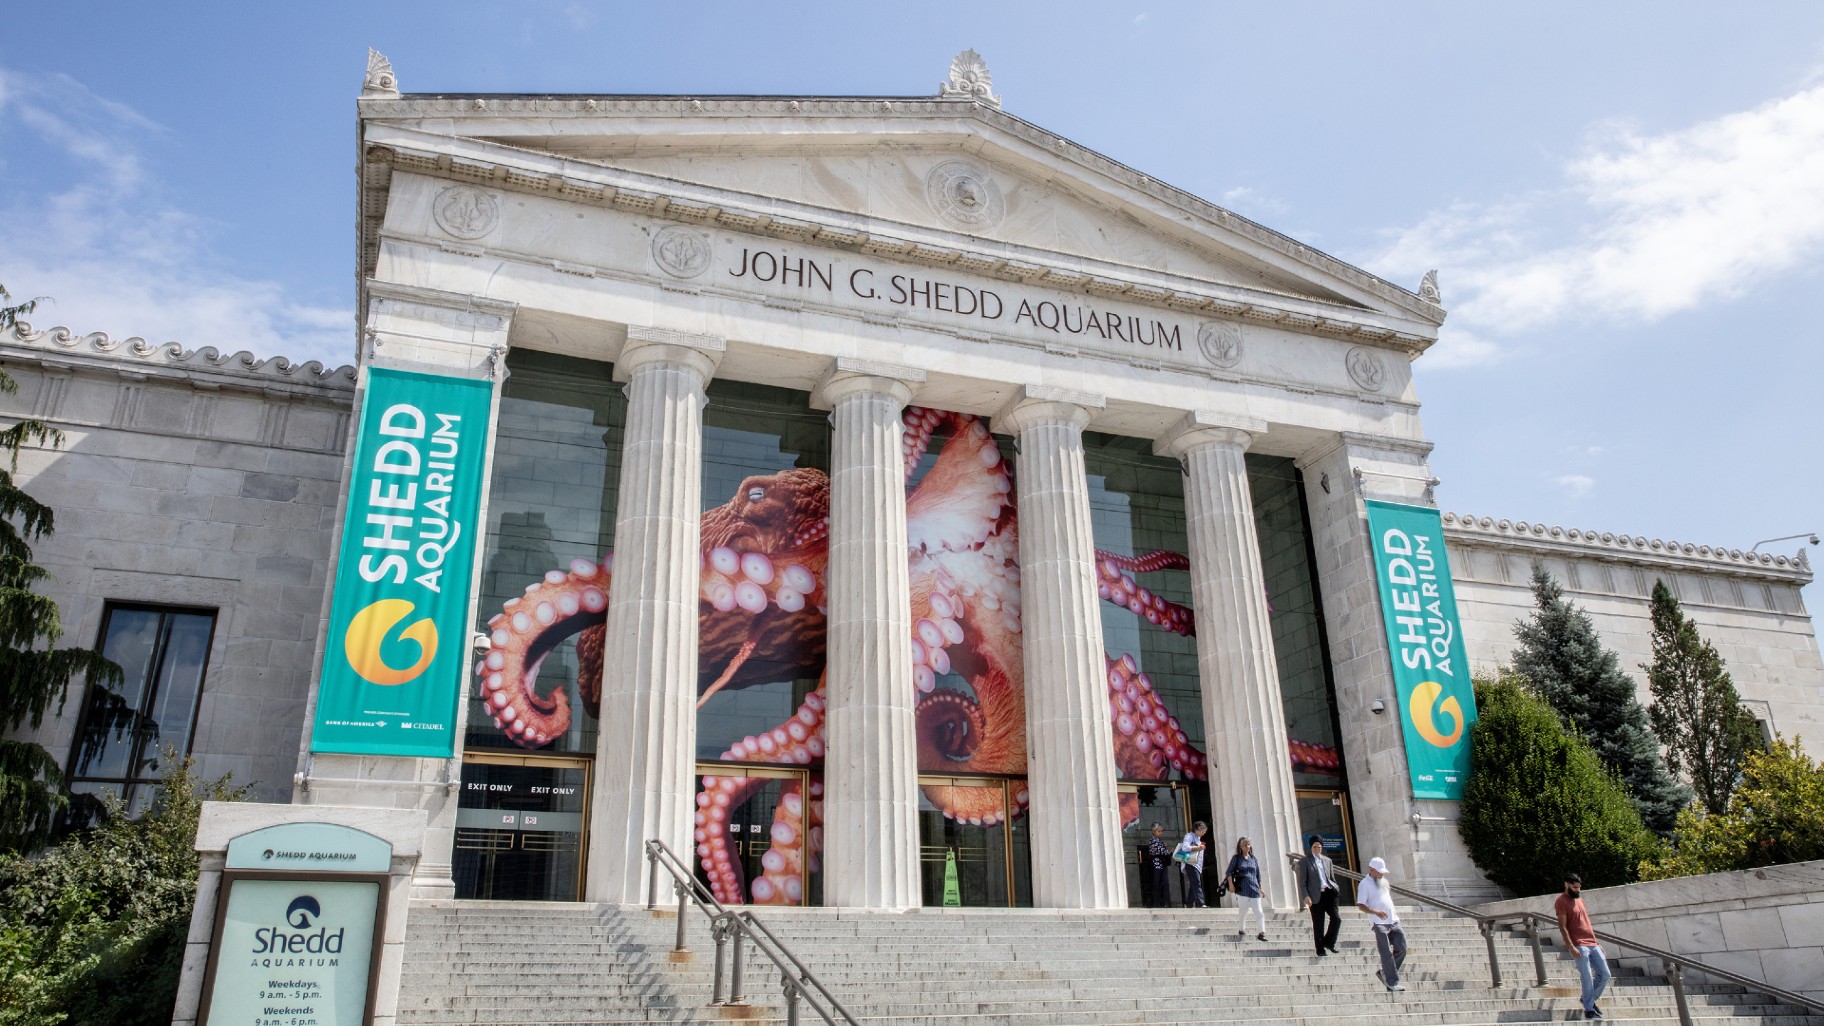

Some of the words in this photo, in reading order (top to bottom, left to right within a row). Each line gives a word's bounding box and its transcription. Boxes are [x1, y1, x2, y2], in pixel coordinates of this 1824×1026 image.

[728, 248, 833, 292] JOHN
[849, 268, 882, 301] G.
[888, 275, 1003, 320] SHEDD
[1014, 298, 1183, 351] AQUARIUM
[358, 403, 426, 584] SHEDD
[413, 413, 462, 594] AQUARIUM
[1383, 528, 1432, 671] SHEDD
[1412, 535, 1454, 677] AQUARIUM
[413, 722, 445, 731] CITADEL
[467, 782, 488, 791] EXIT
[489, 784, 513, 792] ONLY
[531, 786, 551, 794] EXIT
[552, 787, 575, 795] ONLY
[276, 851, 307, 859] SHEDD
[308, 852, 357, 860] AQUARIUM
[252, 926, 345, 954] Shedd
[250, 958, 339, 968] AQUARIUM
[268, 980, 318, 990] Weekdays
[259, 990, 266, 999] 9
[294, 990, 301, 999] 5
[302, 991, 322, 1000] p.m.
[263, 1006, 315, 1015] Weekends
[291, 1018, 297, 1026] 6
